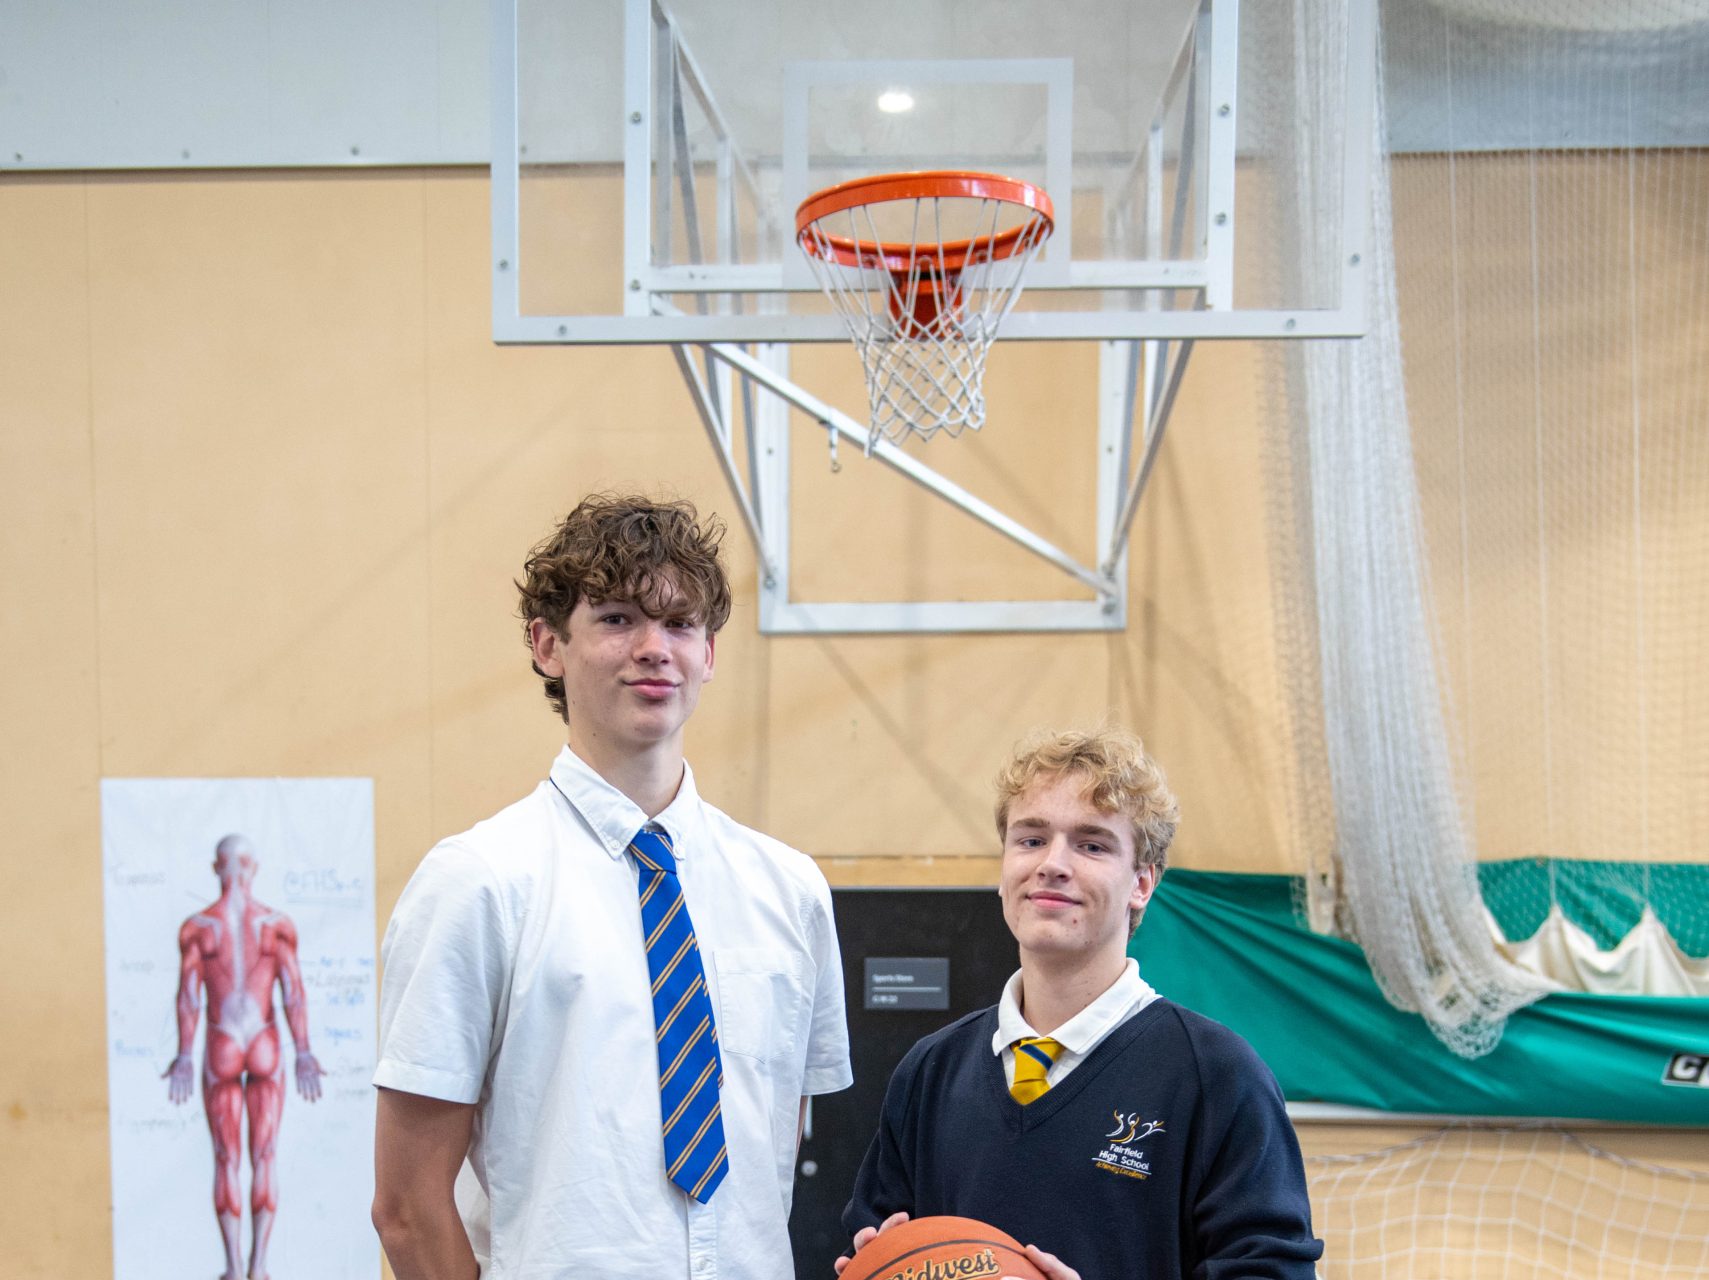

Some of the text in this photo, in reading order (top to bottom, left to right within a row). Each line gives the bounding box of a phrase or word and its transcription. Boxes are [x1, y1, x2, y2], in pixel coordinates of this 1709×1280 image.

[1110, 1143, 1143, 1159] Fairfield
[1099, 1150, 1149, 1171] High School
